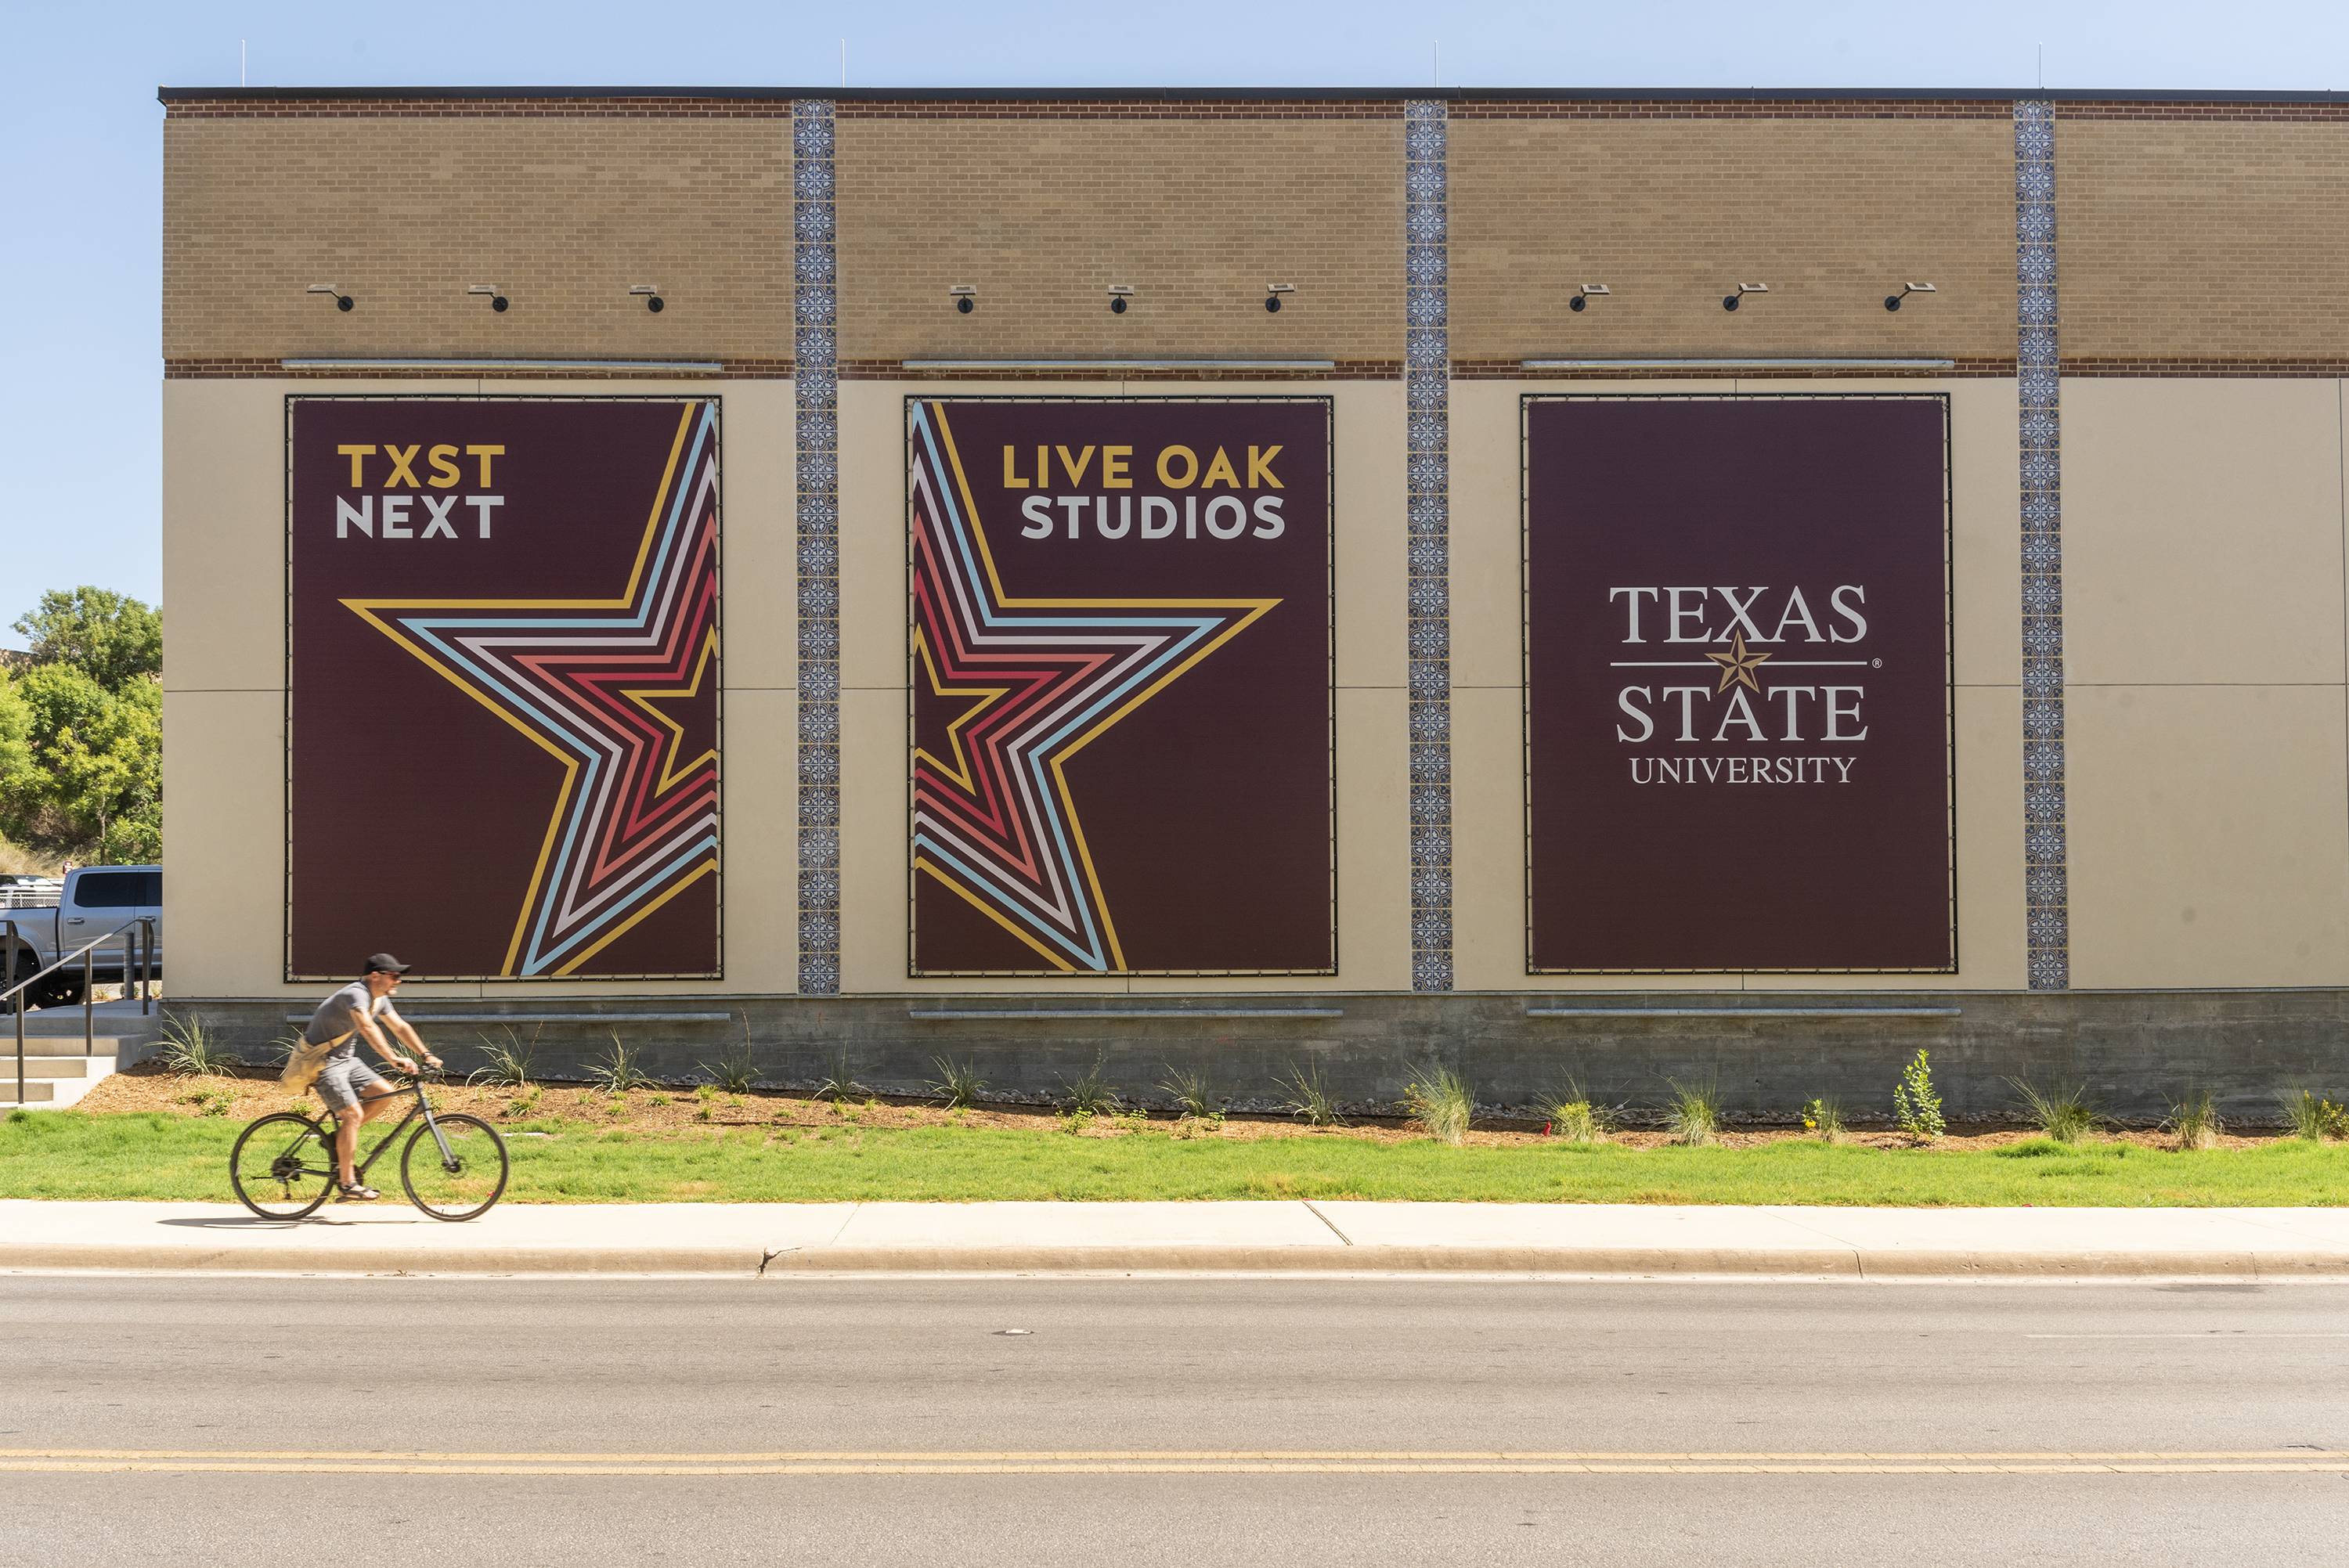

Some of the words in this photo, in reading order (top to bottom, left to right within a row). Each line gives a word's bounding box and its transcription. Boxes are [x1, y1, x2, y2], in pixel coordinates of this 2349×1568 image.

[337, 445, 505, 488] TXST
[1003, 445, 1133, 488] LIVE
[1156, 445, 1285, 489] OAK
[336, 495, 505, 539] NEXT
[1020, 495, 1286, 539] STUDIOS
[1609, 585, 1867, 643] TEXAS
[1616, 685, 1868, 743] STATE
[1628, 756, 1857, 784] UNIVERSITY
